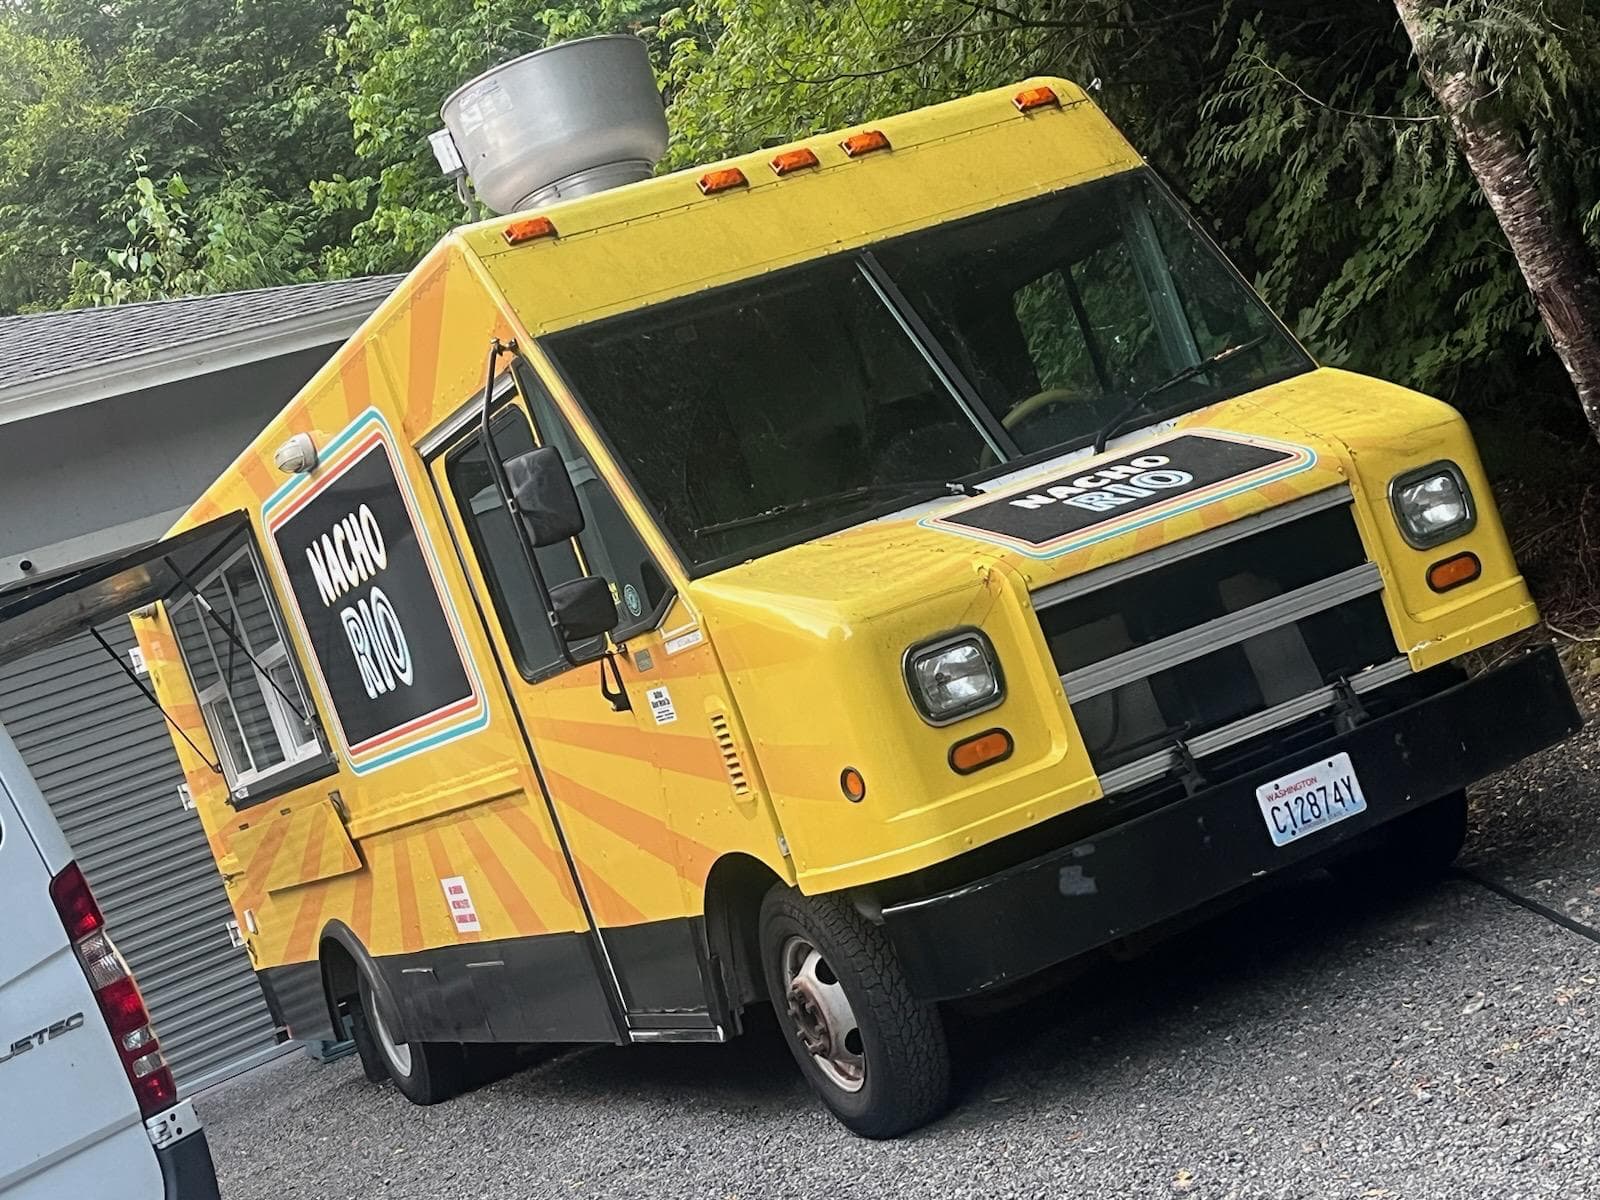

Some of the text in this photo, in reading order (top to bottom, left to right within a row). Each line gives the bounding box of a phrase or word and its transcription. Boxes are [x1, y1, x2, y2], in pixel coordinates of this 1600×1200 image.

[1009, 455, 1170, 509] NACHO
[1063, 470, 1194, 512] RIO
[305, 503, 387, 608] NACHO
[340, 586, 414, 700] RIO
[1266, 776, 1318, 802] WASHINGTON
[1271, 775, 1356, 834] C12874Y
